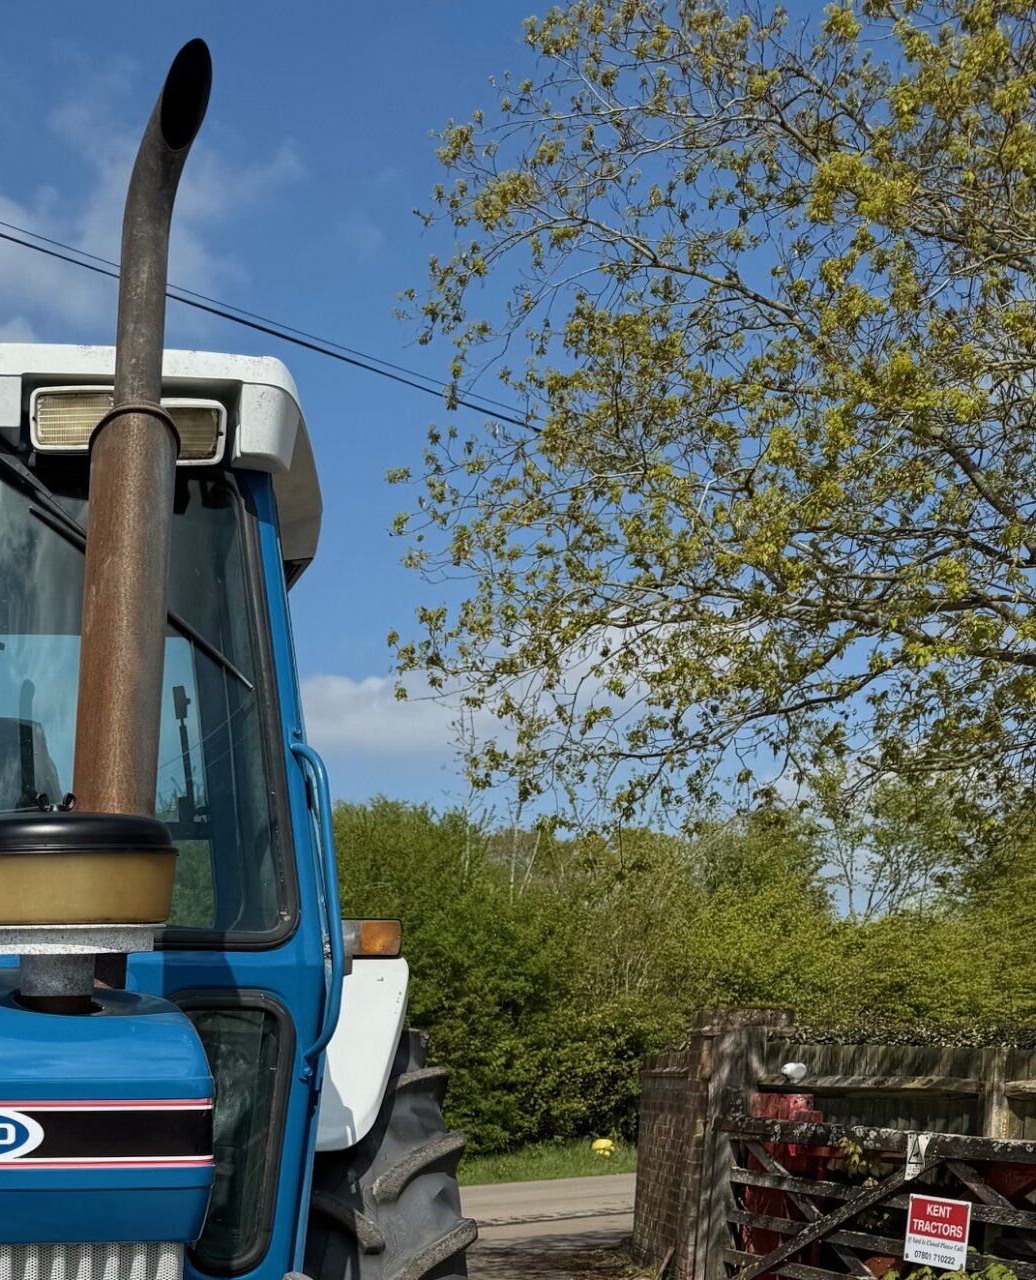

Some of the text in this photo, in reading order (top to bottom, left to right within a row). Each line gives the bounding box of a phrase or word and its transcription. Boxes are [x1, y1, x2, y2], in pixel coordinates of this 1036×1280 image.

[926, 1203, 952, 1218] KENT
[912, 1218, 963, 1238] TRACTORS
[914, 1250, 956, 1265] 07801 710222
